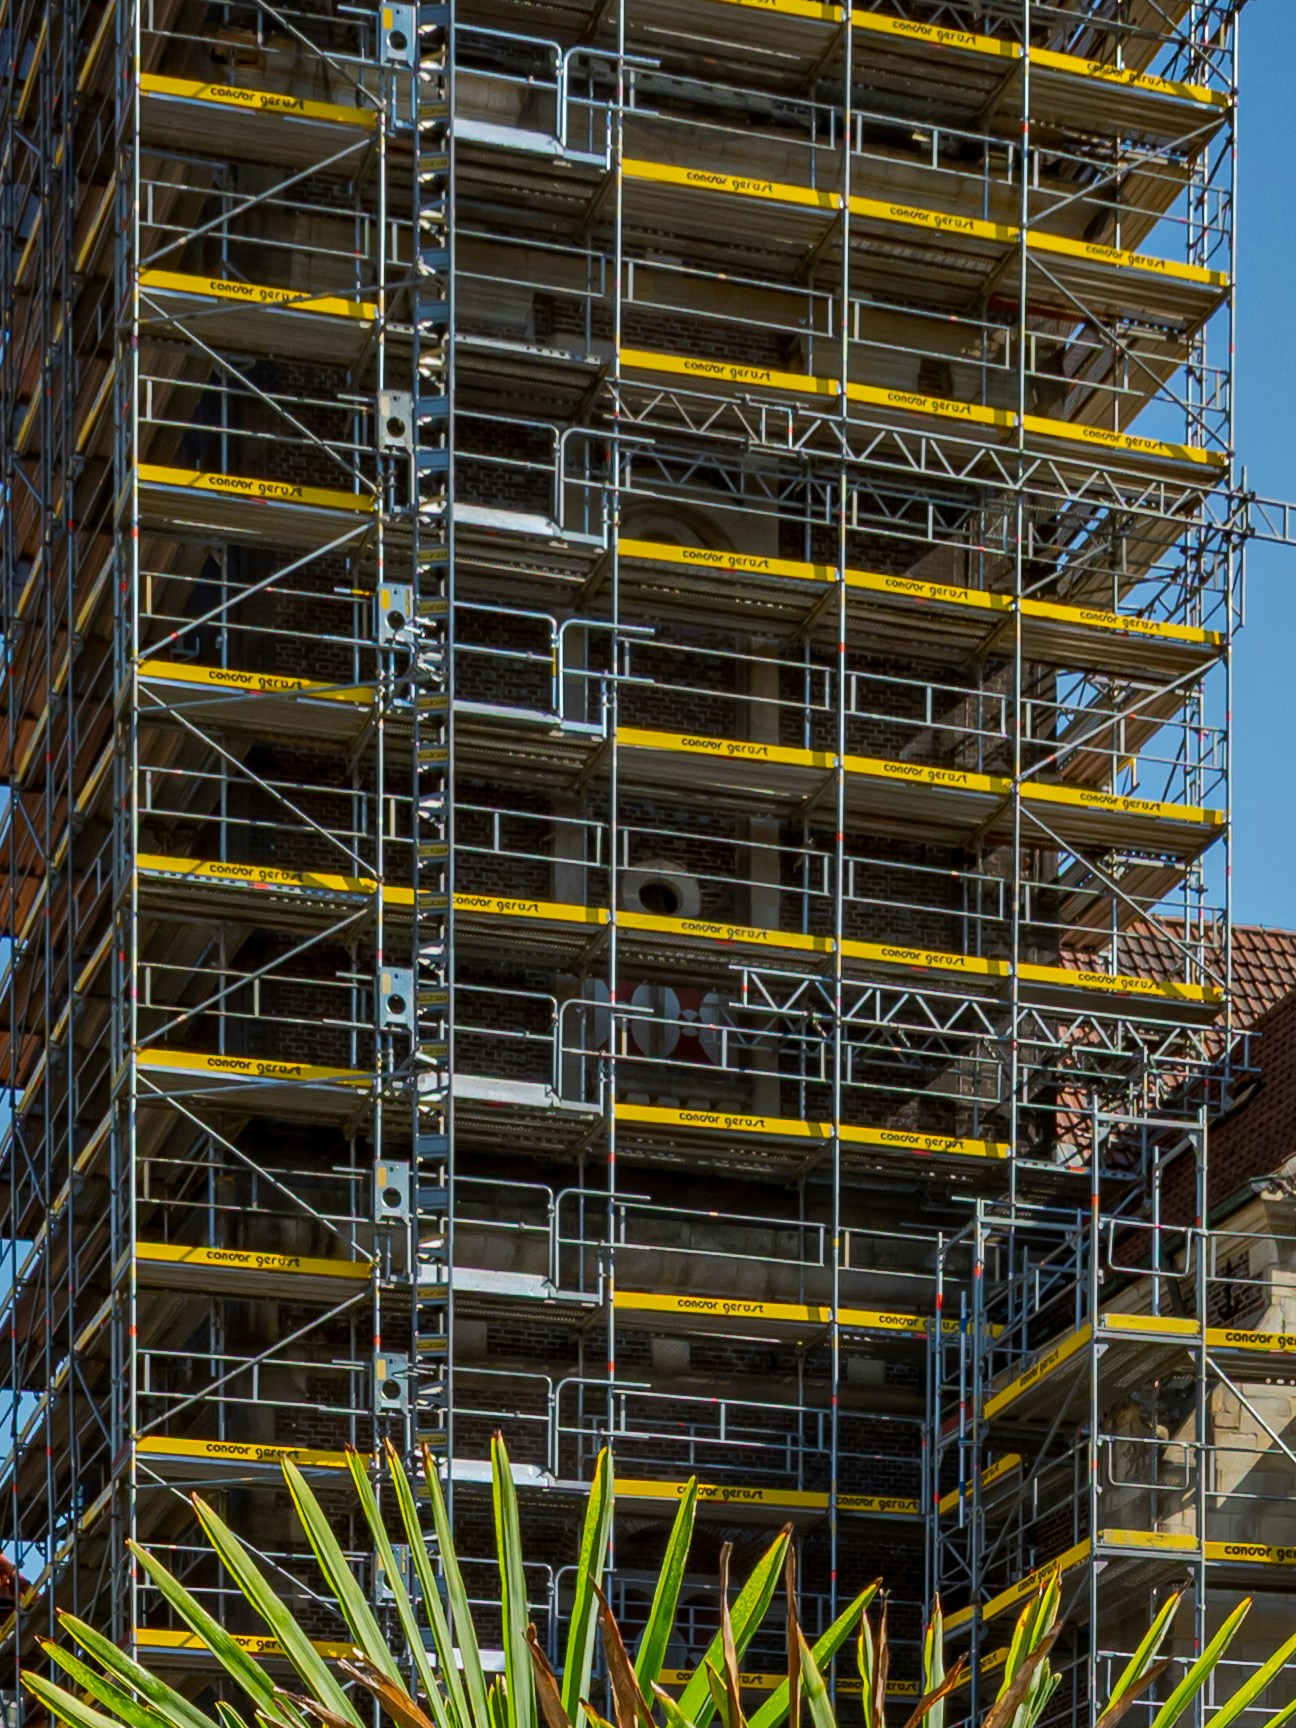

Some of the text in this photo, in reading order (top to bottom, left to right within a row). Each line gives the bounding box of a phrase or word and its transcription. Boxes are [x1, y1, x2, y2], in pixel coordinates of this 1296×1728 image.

[892, 21, 933, 35] condor
[211, 87, 255, 101] condor
[687, 171, 727, 185] condor
[890, 207, 929, 221] condor
[1086, 246, 1122, 259] condor
[210, 281, 254, 295] condor
[684, 361, 724, 374] condor
[888, 393, 926, 407] condor
[1083, 429, 1120, 442] condor
[209, 476, 253, 490] condor
[682, 550, 723, 563] condor
[885, 579, 924, 592] condor
[1081, 611, 1117, 624] condor
[209, 670, 252, 683] condor
[681, 738, 721, 749] condor
[884, 764, 923, 776] condor
[1080, 793, 1117, 805] condor
[210, 865, 253, 876] condor
[681, 922, 721, 933] condor
[881, 948, 919, 960] condor
[1079, 973, 1116, 984] condor
[208, 1058, 251, 1070] condor
[680, 1113, 719, 1123] condor
[880, 1132, 919, 1143] condor
[207, 1251, 250, 1262] condor
[678, 1298, 718, 1309] condor
[879, 1315, 919, 1327] condor
[1226, 1331, 1272, 1344] condor
[206, 1444, 249, 1455] condor
[1224, 1545, 1272, 1556] condor
